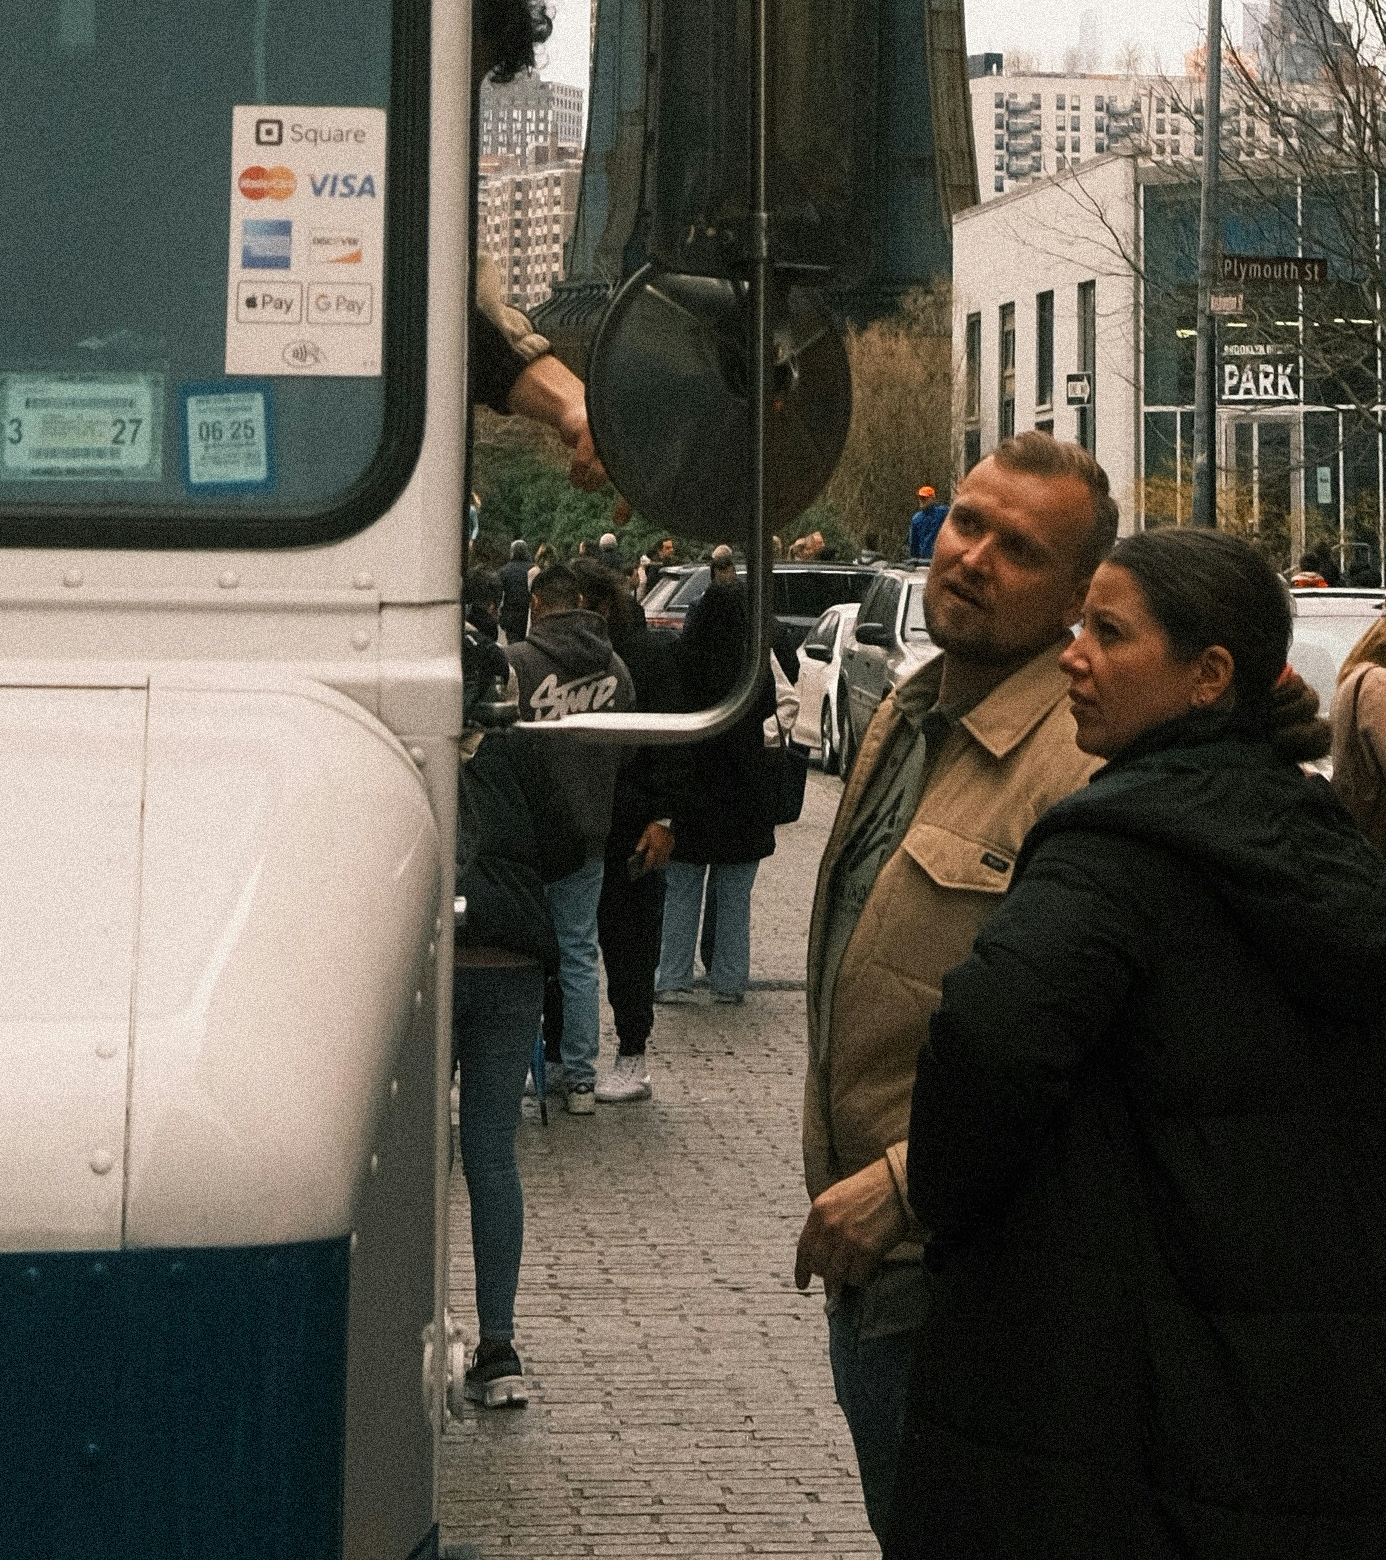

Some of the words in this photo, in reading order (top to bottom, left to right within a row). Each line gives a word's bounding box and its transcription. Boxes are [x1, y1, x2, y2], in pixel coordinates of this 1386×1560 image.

[290, 123, 366, 147] Square
[309, 173, 376, 198] VISA
[1224, 258, 1299, 282] Plymouth
[1304, 263, 1319, 281] St
[262, 294, 293, 314] Pay
[336, 296, 365, 315] Pay
[1223, 364, 1295, 397] PARK
[8, 418, 23, 445] 3
[112, 418, 143, 445] 27
[198, 420, 223, 442] 06
[230, 419, 256, 441] 25
